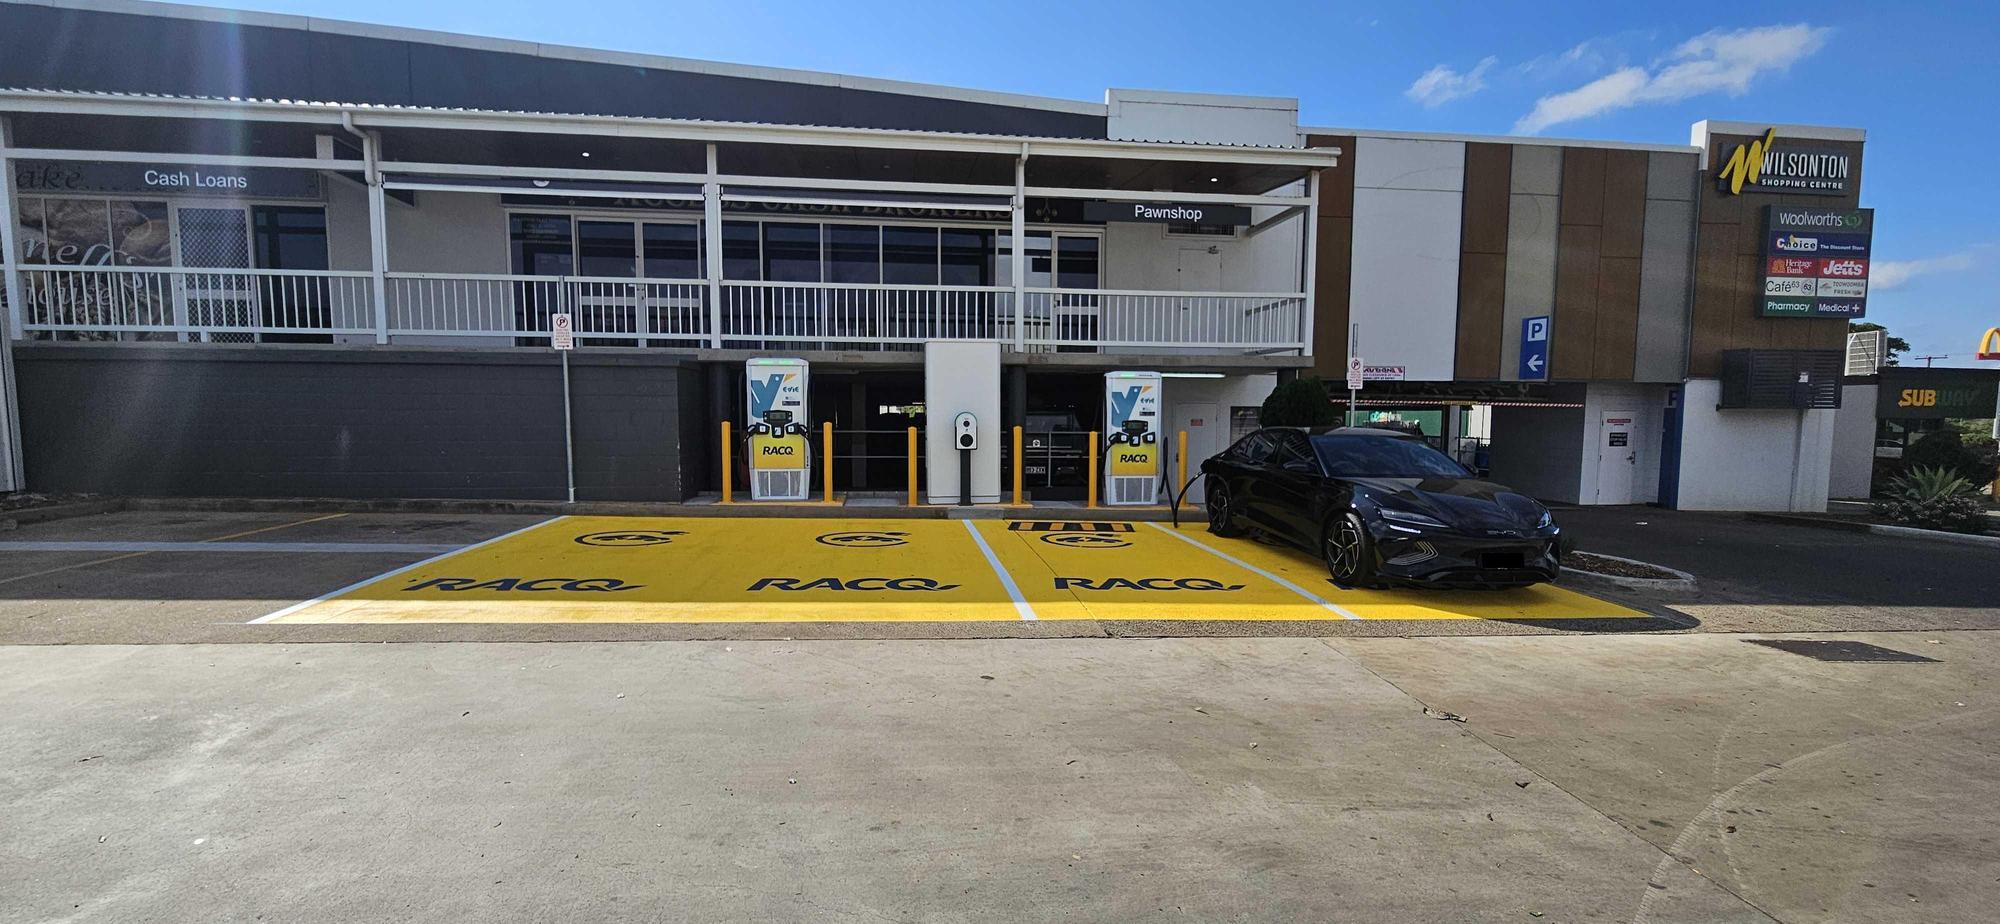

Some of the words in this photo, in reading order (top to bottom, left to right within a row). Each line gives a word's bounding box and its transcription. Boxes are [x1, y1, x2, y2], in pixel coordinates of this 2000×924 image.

[1761, 151, 1848, 178] WILSONTON
[144, 169, 190, 187] Cash
[195, 172, 248, 189] Loans
[1761, 178, 1806, 188] SHOPPING
[1810, 181, 1844, 190] CENTRE
[1134, 204, 1202, 222] Pawnshop
[1779, 211, 1843, 227] Woolworths
[1785, 259, 1812, 268] Heritage
[1823, 260, 1863, 276] Jetts
[1767, 301, 1810, 312] Pharmacy
[1818, 303, 1849, 312] Medical
[1531, 322, 1543, 339] P
[762, 446, 794, 456] RACQ
[1120, 454, 1148, 463] RACQ
[402, 577, 647, 592] RACQ
[746, 577, 962, 592] RACQ
[1053, 577, 1246, 592] RACQ
